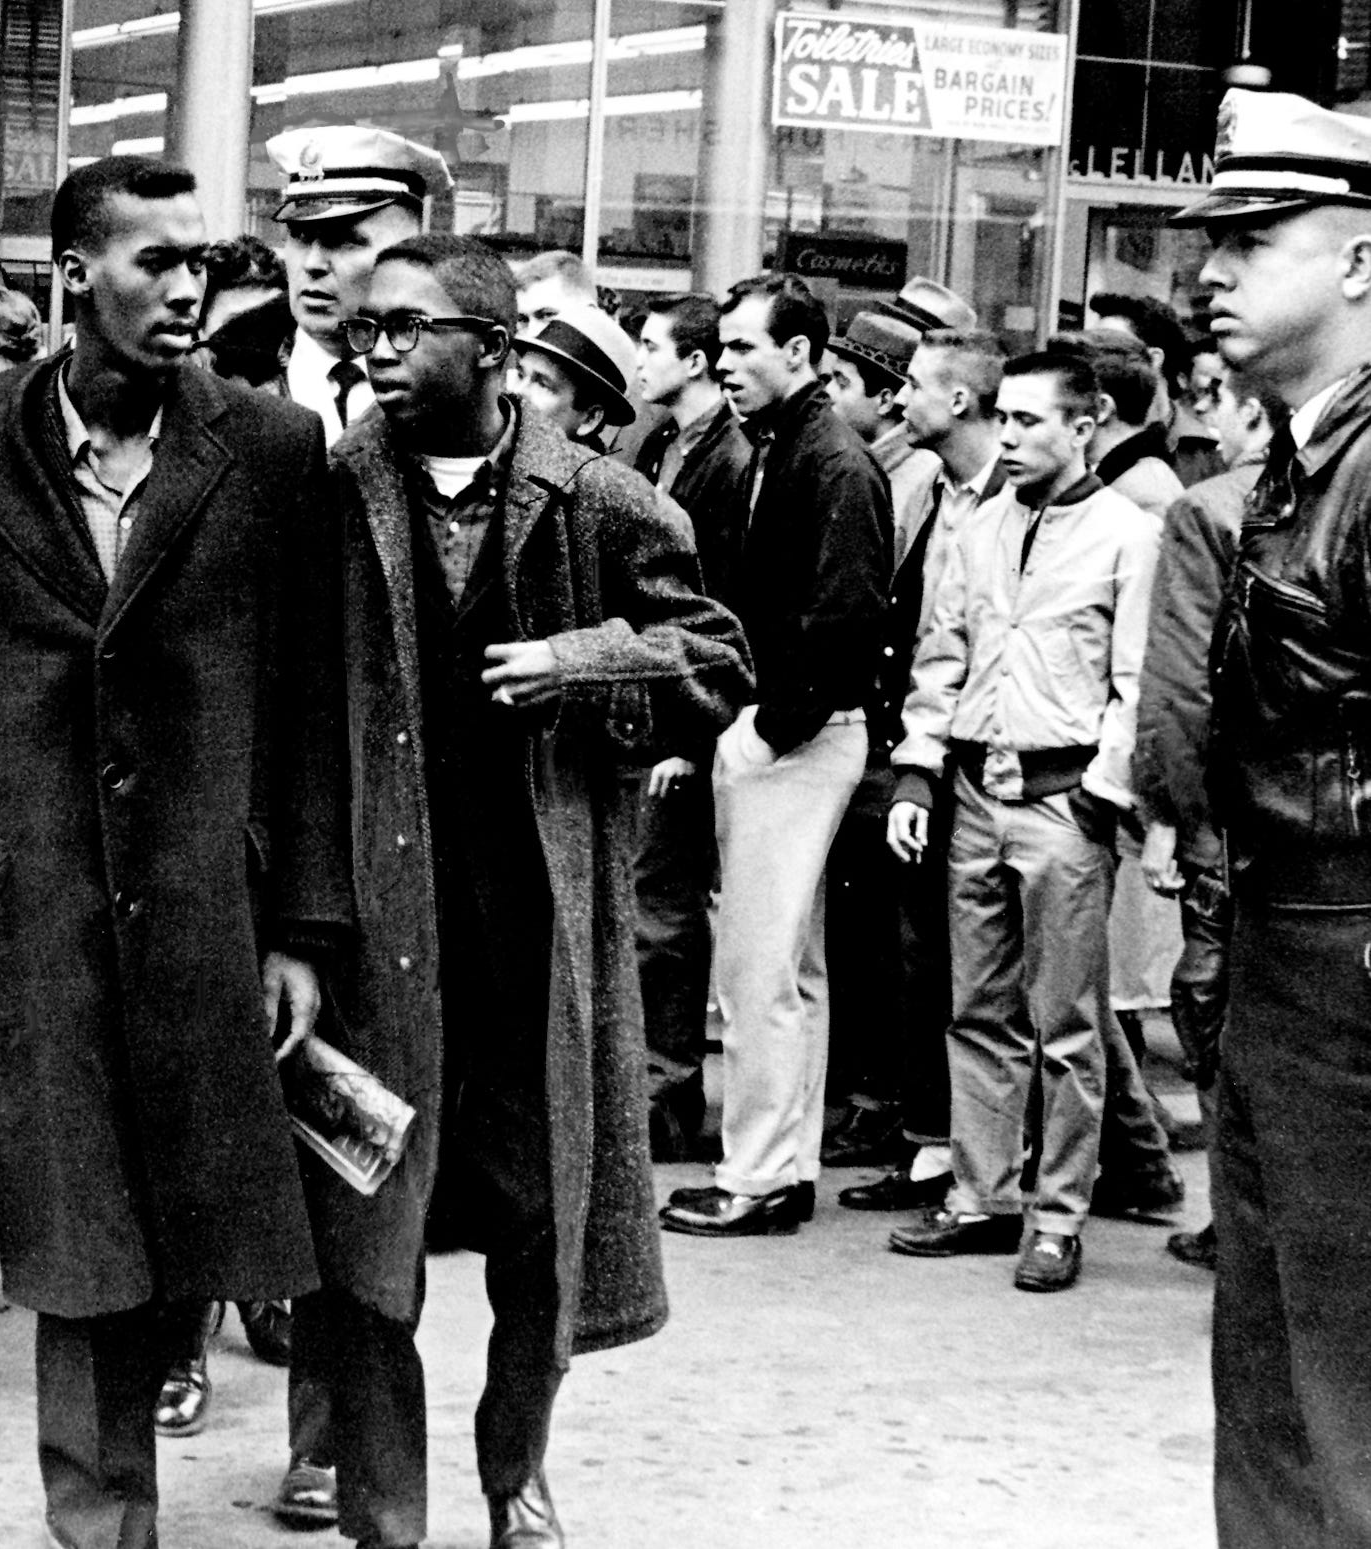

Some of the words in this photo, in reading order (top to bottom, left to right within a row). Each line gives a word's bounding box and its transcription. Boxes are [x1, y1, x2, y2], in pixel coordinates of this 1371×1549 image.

[782, 20, 916, 69] Toiletries
[925, 36, 963, 54] LARGE
[969, 40, 1025, 57] ECONOMY
[1028, 44, 1060, 60] SIZES
[786, 63, 923, 123] SALE
[933, 68, 1035, 97] BARGAIN
[964, 92, 1057, 122] PRICES!
[795, 248, 899, 275] Cosmetics
